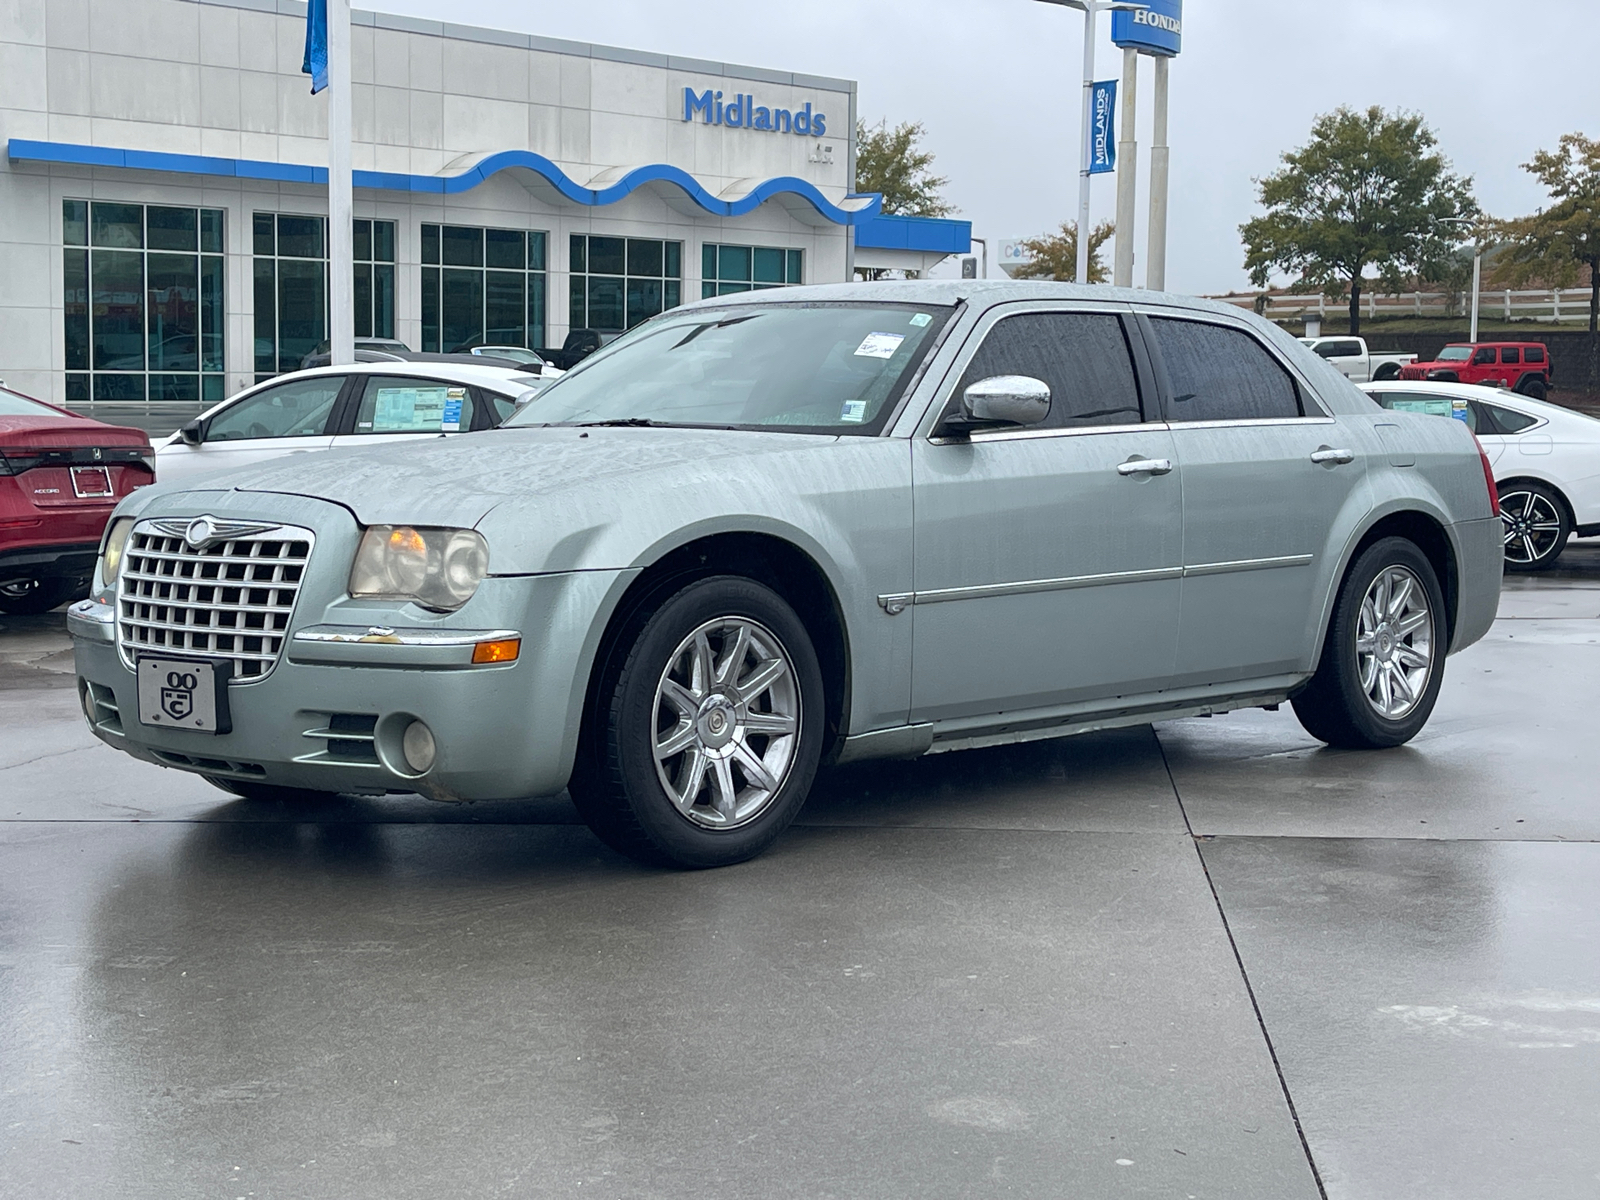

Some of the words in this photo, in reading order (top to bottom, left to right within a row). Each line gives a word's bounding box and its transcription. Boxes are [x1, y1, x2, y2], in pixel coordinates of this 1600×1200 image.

[1133, 10, 1181, 34] HONDA
[682, 87, 826, 136] Midlands
[1095, 88, 1106, 165] MIDLANDS
[169, 700, 184, 714] C
